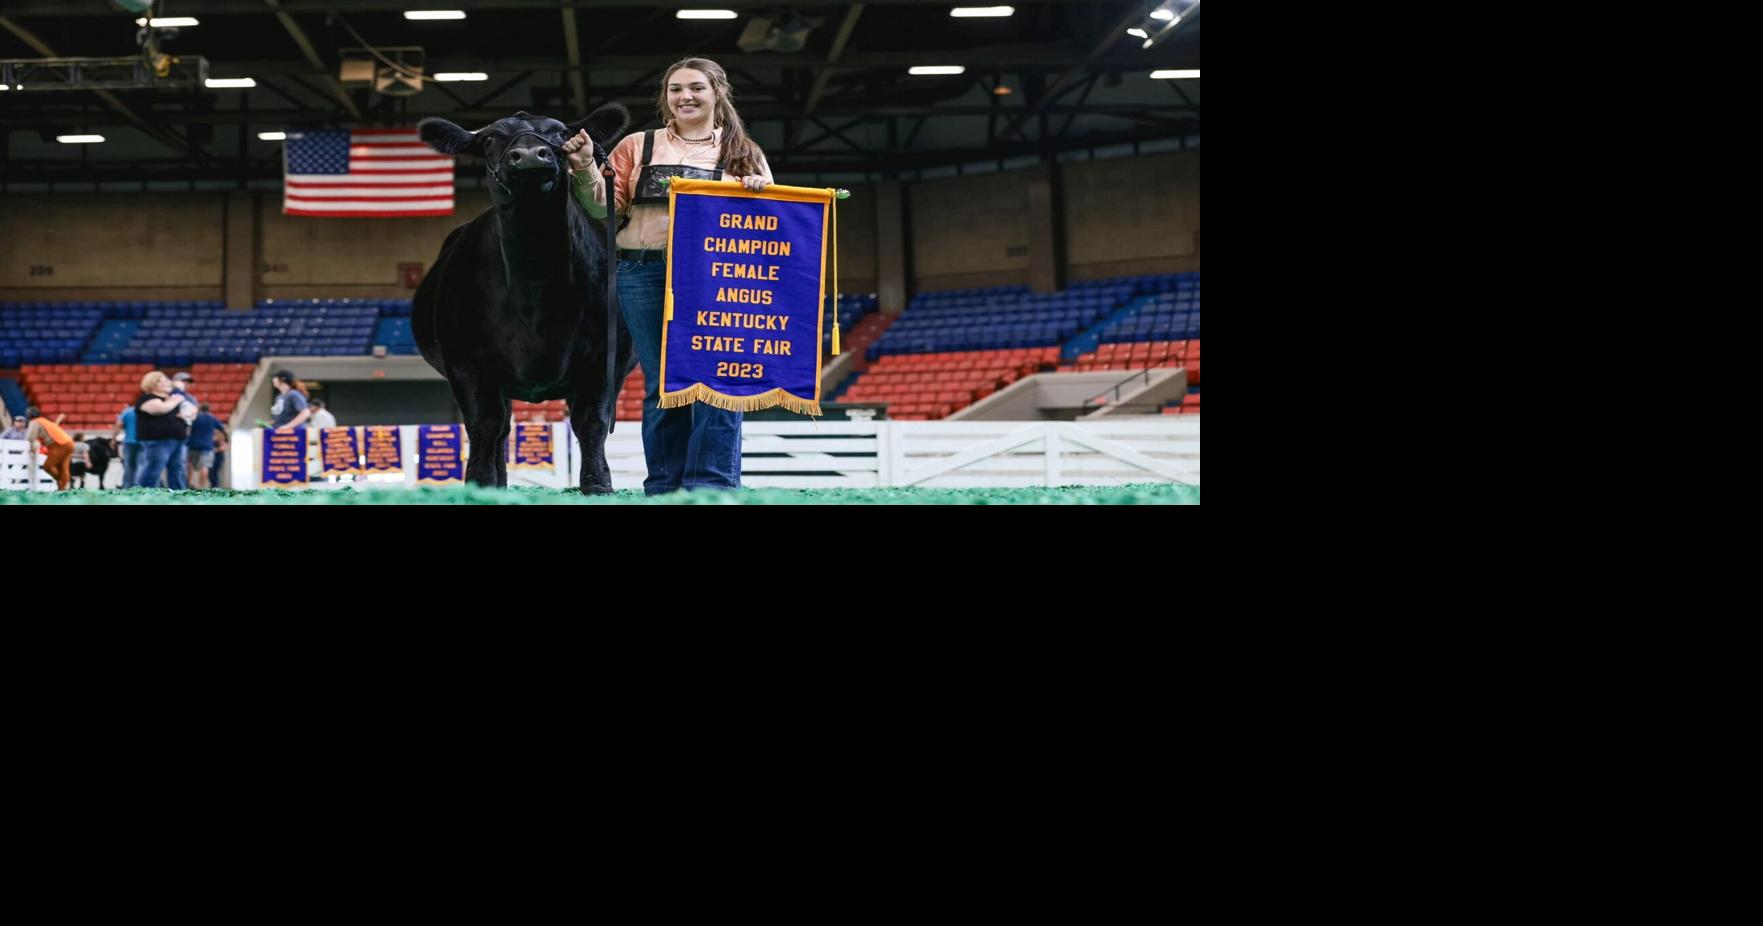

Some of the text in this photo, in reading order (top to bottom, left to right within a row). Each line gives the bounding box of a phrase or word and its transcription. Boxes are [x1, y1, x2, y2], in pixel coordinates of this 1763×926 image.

[719, 213, 778, 231] GRAND
[704, 237, 791, 256] CHAMPION
[711, 262, 779, 281] FEMALE
[716, 287, 773, 305] ANGUS
[696, 310, 790, 330] KENTUCKY
[691, 335, 791, 356] STATE FAIR
[716, 361, 764, 379] 2023
